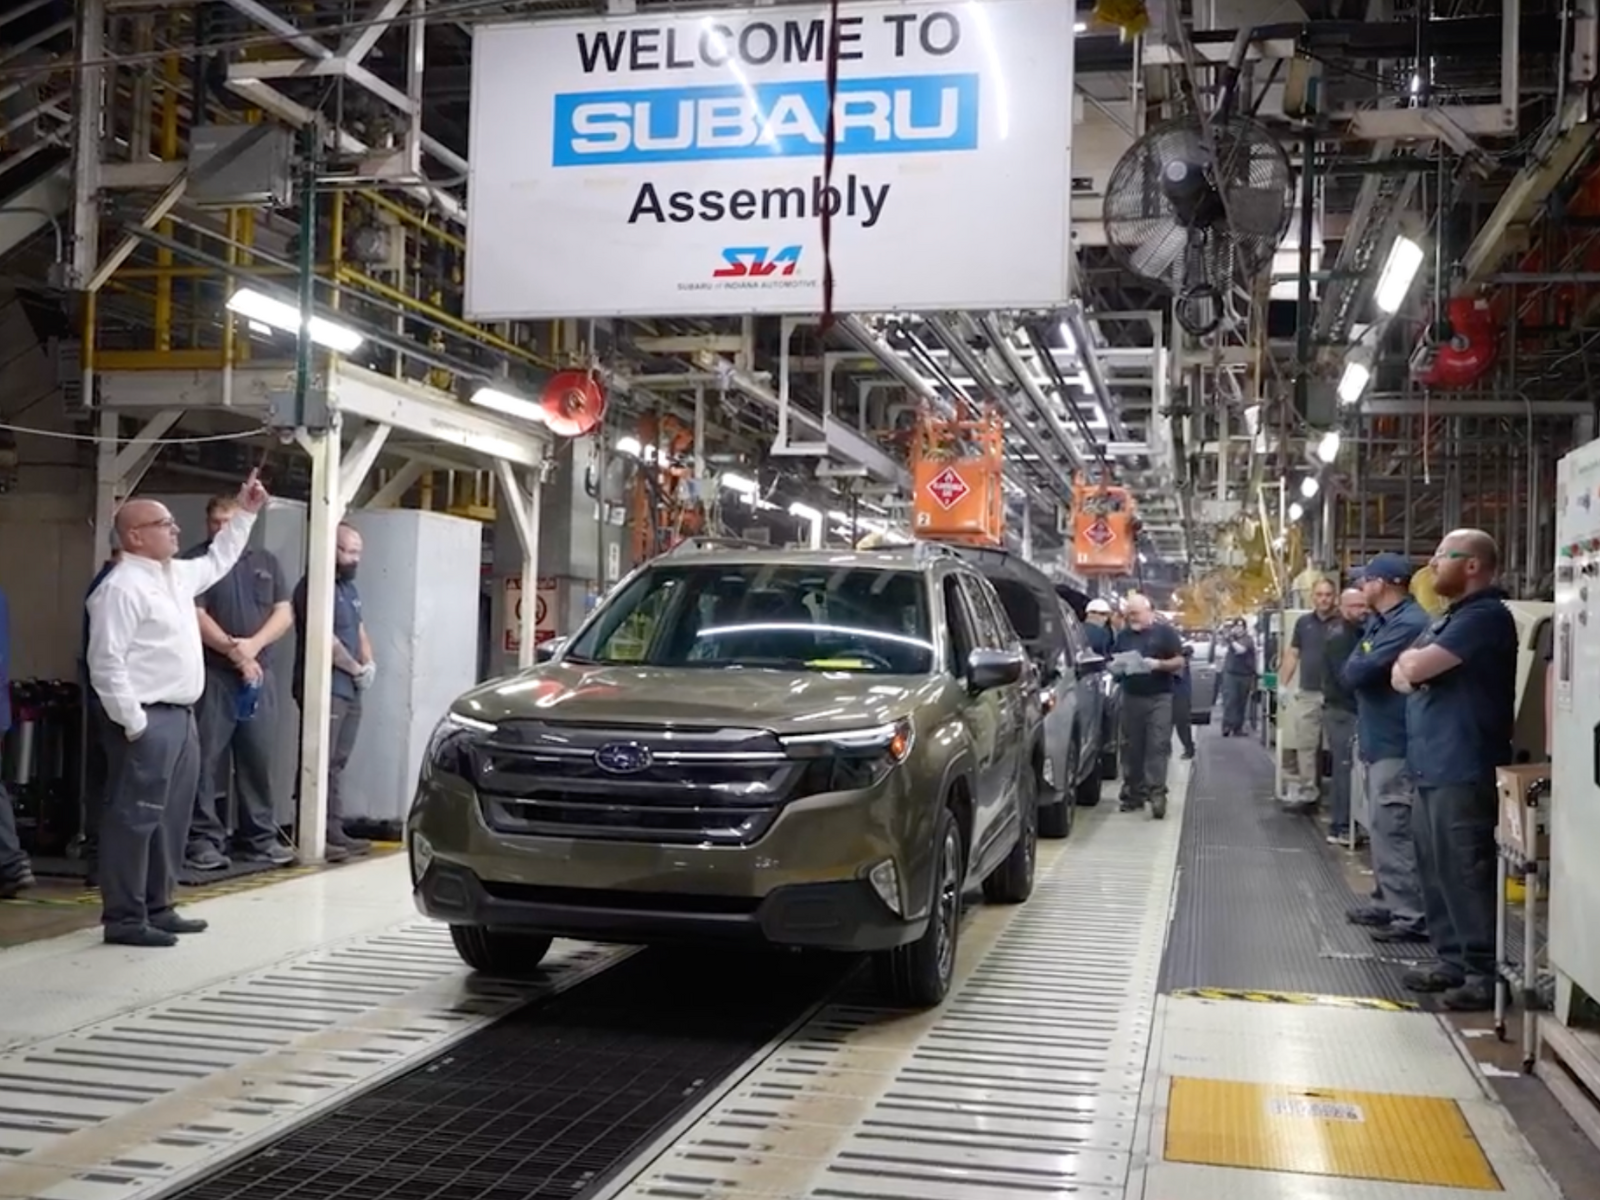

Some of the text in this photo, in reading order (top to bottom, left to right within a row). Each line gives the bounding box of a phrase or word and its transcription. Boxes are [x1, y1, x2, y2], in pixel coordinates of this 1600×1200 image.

[576, 11, 960, 73] WELCOME TO
[571, 87, 959, 154] SUBARU
[627, 174, 891, 228] Assembly
[677, 282, 713, 291] SUBARU
[724, 280, 759, 290] INDIANA
